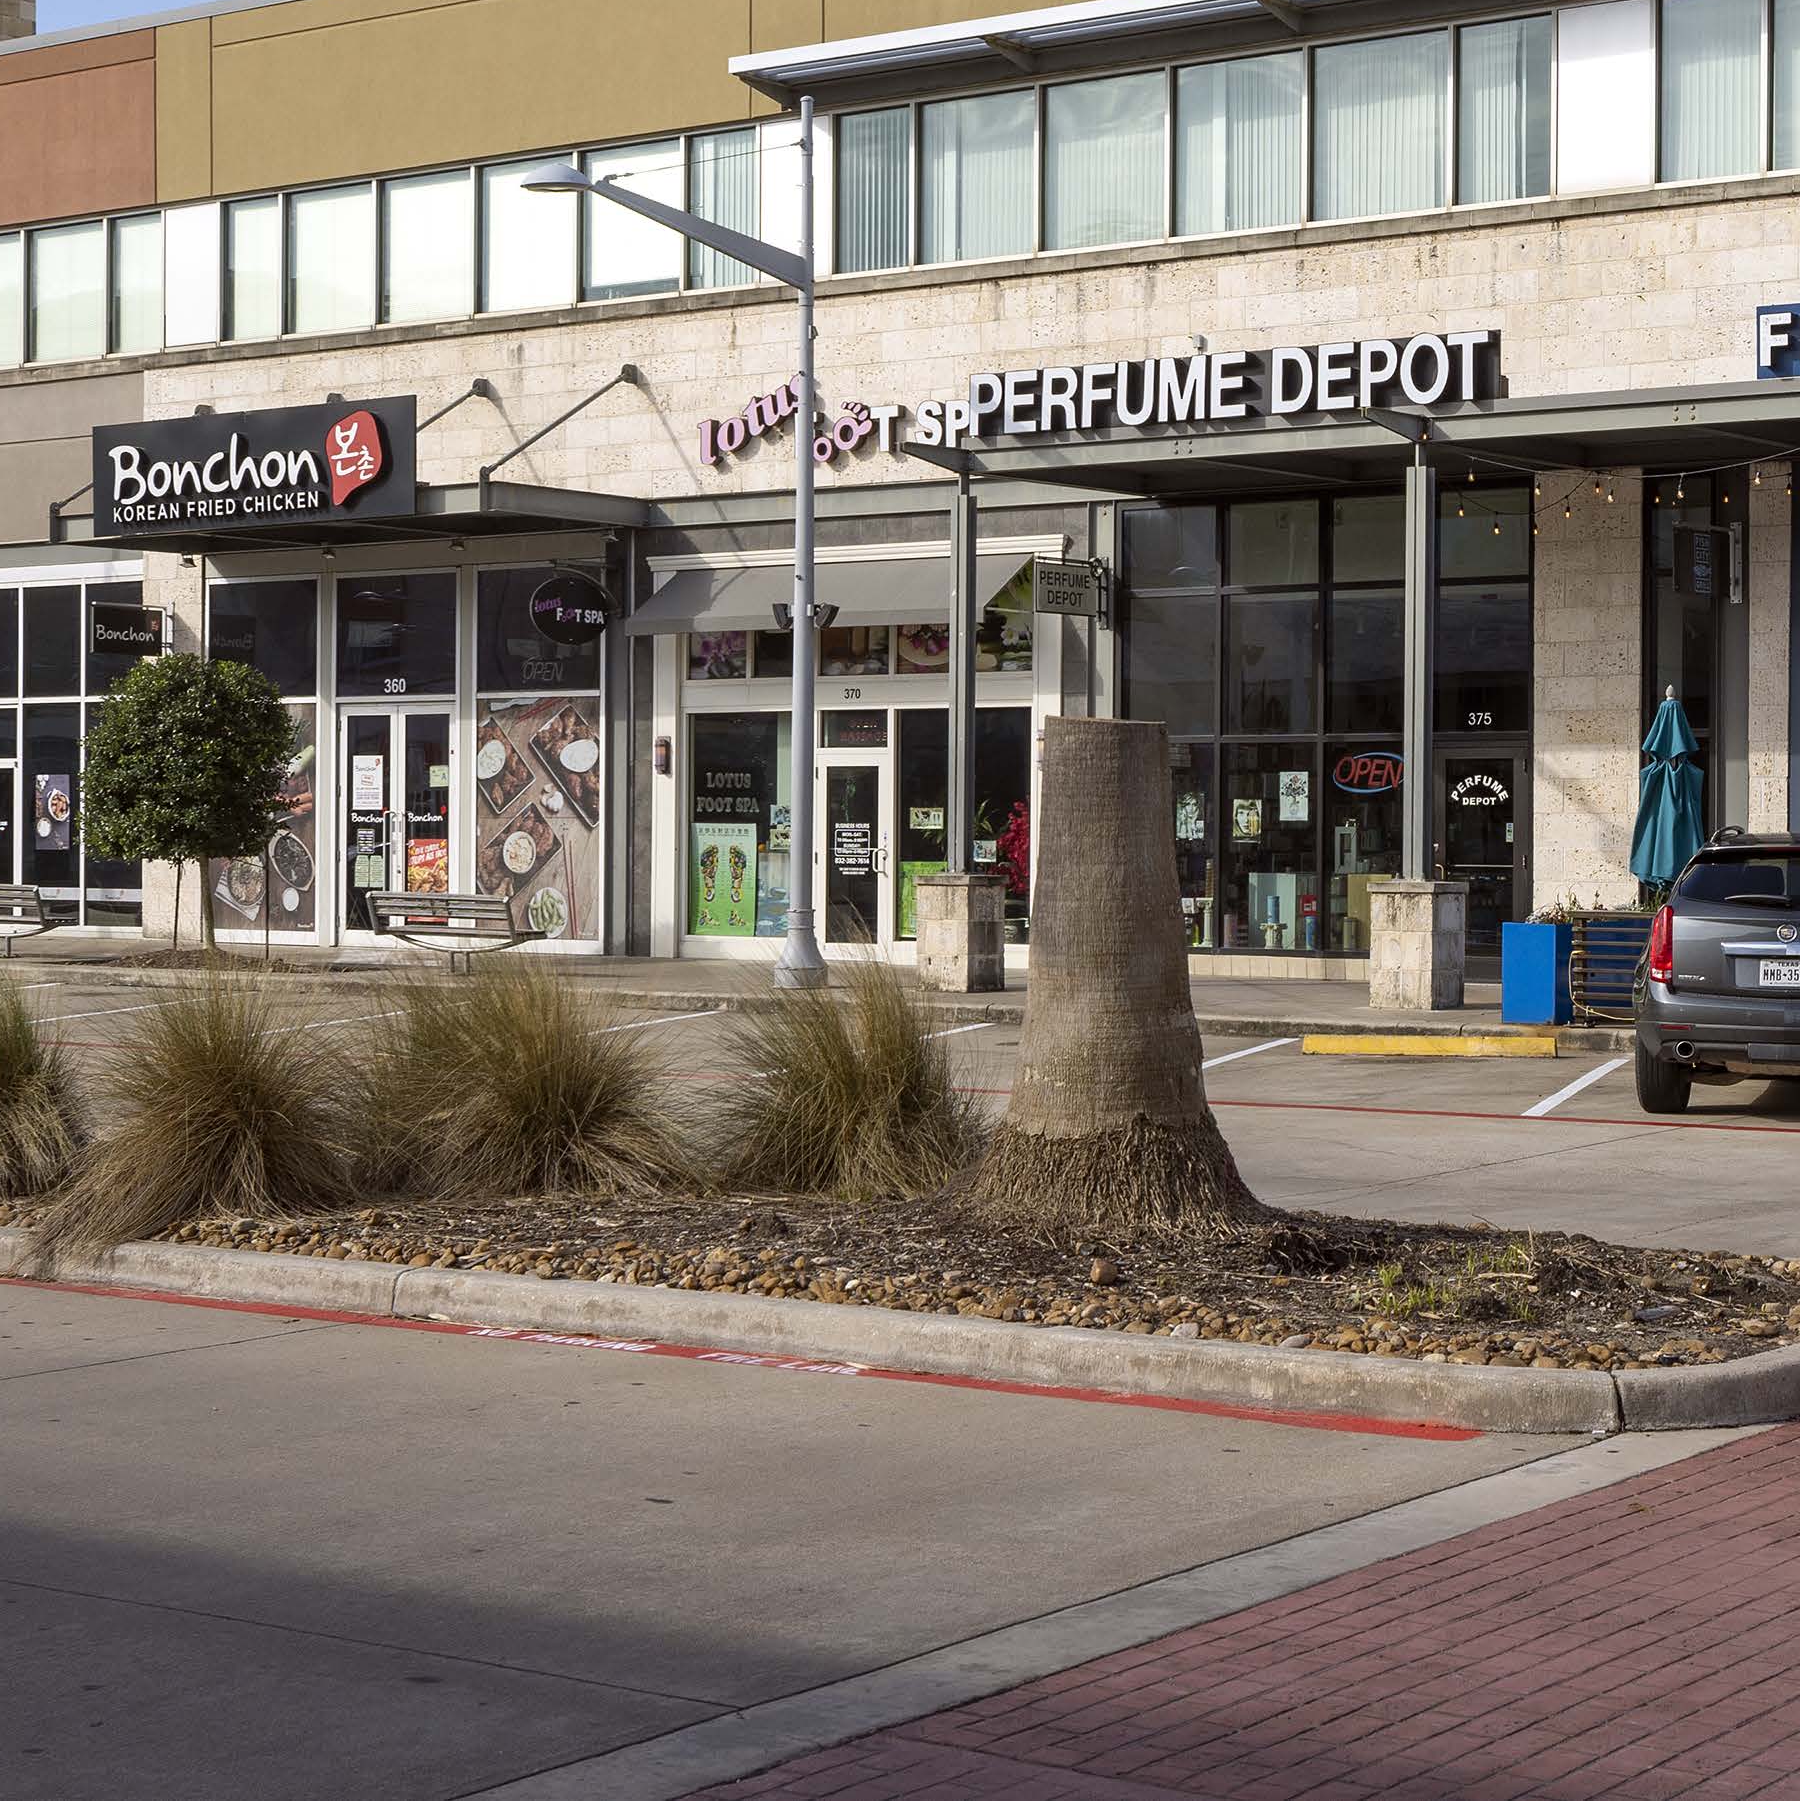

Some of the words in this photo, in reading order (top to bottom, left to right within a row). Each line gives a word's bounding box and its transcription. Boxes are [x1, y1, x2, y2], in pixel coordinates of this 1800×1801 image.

[969, 351, 1247, 437] PERFUME
[1271, 330, 1489, 415] DEPOT
[915, 399, 970, 447] SP
[331, 422, 376, 481] 본촌
[108, 432, 319, 505] Bonchon
[112, 502, 180, 524] KOREAN
[186, 498, 237, 519] FRIED
[243, 490, 320, 514] CHICKEN
[1039, 570, 1091, 589] PERFUME
[1047, 590, 1083, 607] DEPOT
[584, 610, 604, 625] SPA
[95, 624, 155, 643] Bonchon
[383, 678, 407, 693] 360
[843, 688, 861, 699] 370
[1467, 712, 1492, 726] 375
[706, 772, 751, 788] LOTUS
[1335, 756, 1404, 789] OPEN
[1450, 774, 1509, 802] PERFUME
[696, 796, 733, 813] FOOT
[735, 796, 760, 813] SPA
[1461, 797, 1497, 806] DEPOT
[351, 812, 384, 823] Bonchon
[406, 812, 444, 823] Bonchon
